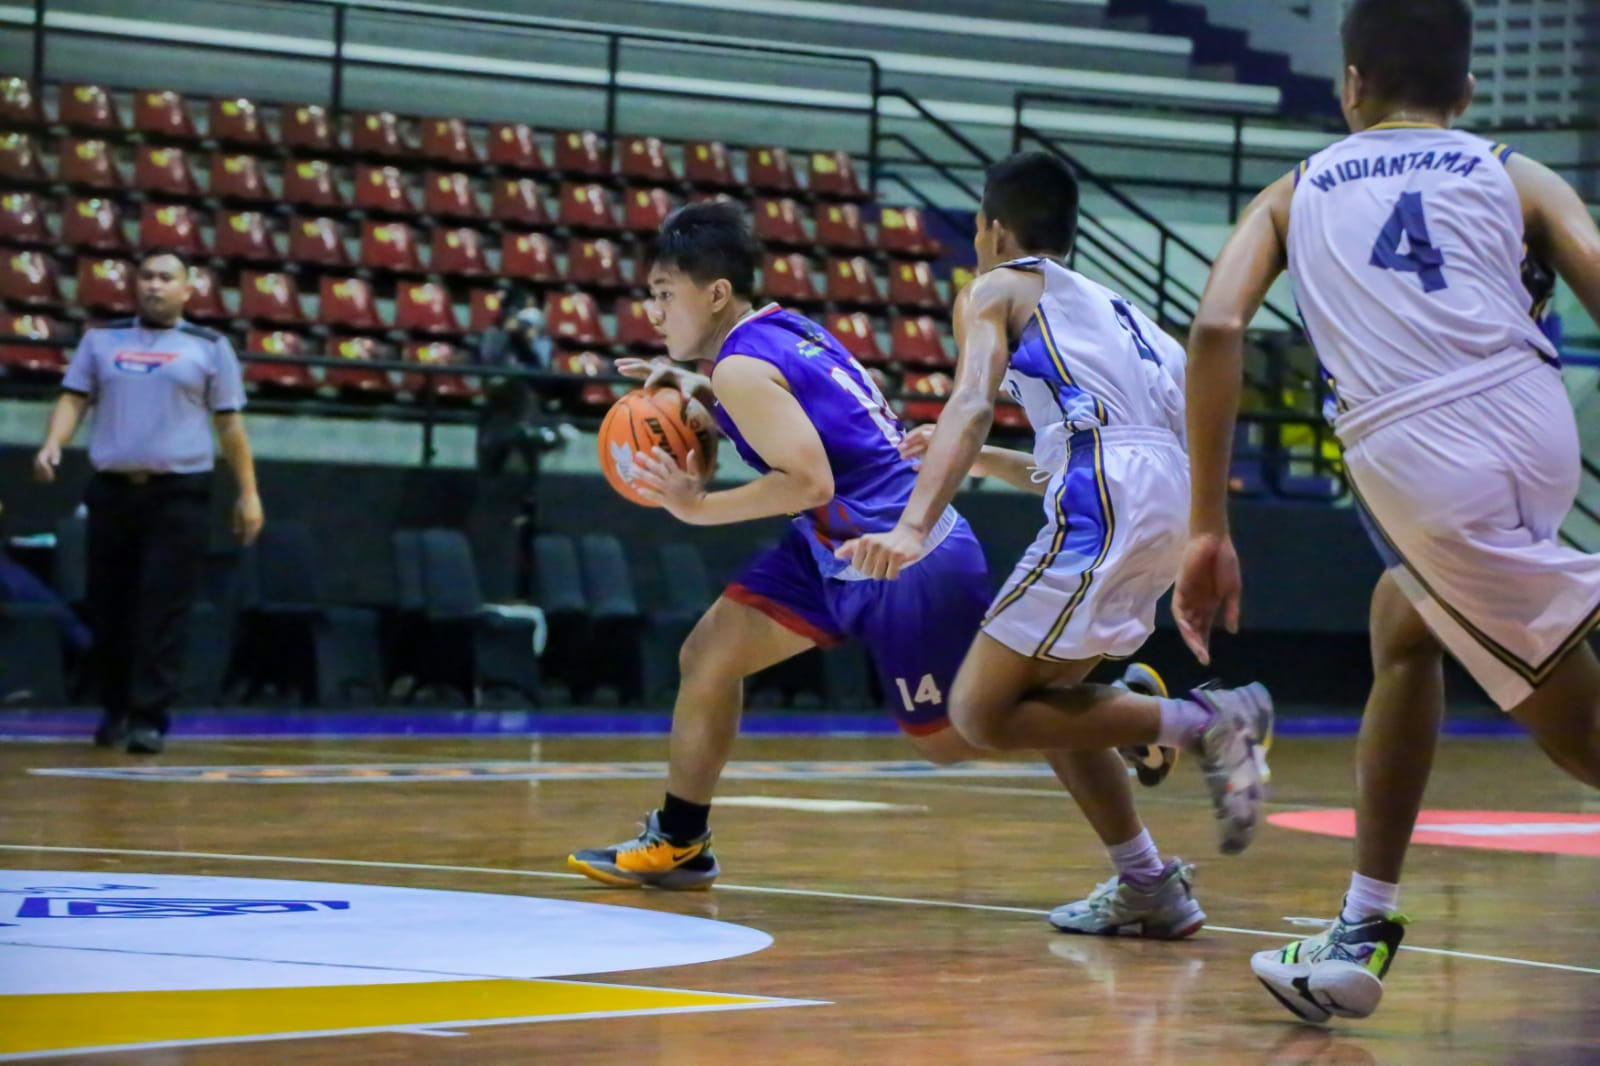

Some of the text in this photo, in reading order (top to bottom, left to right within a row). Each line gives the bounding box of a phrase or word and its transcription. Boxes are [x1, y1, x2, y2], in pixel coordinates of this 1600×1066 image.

[1310, 151, 1482, 193] WIDIANTAMA
[1368, 190, 1449, 294] 4
[895, 673, 942, 712] 14
